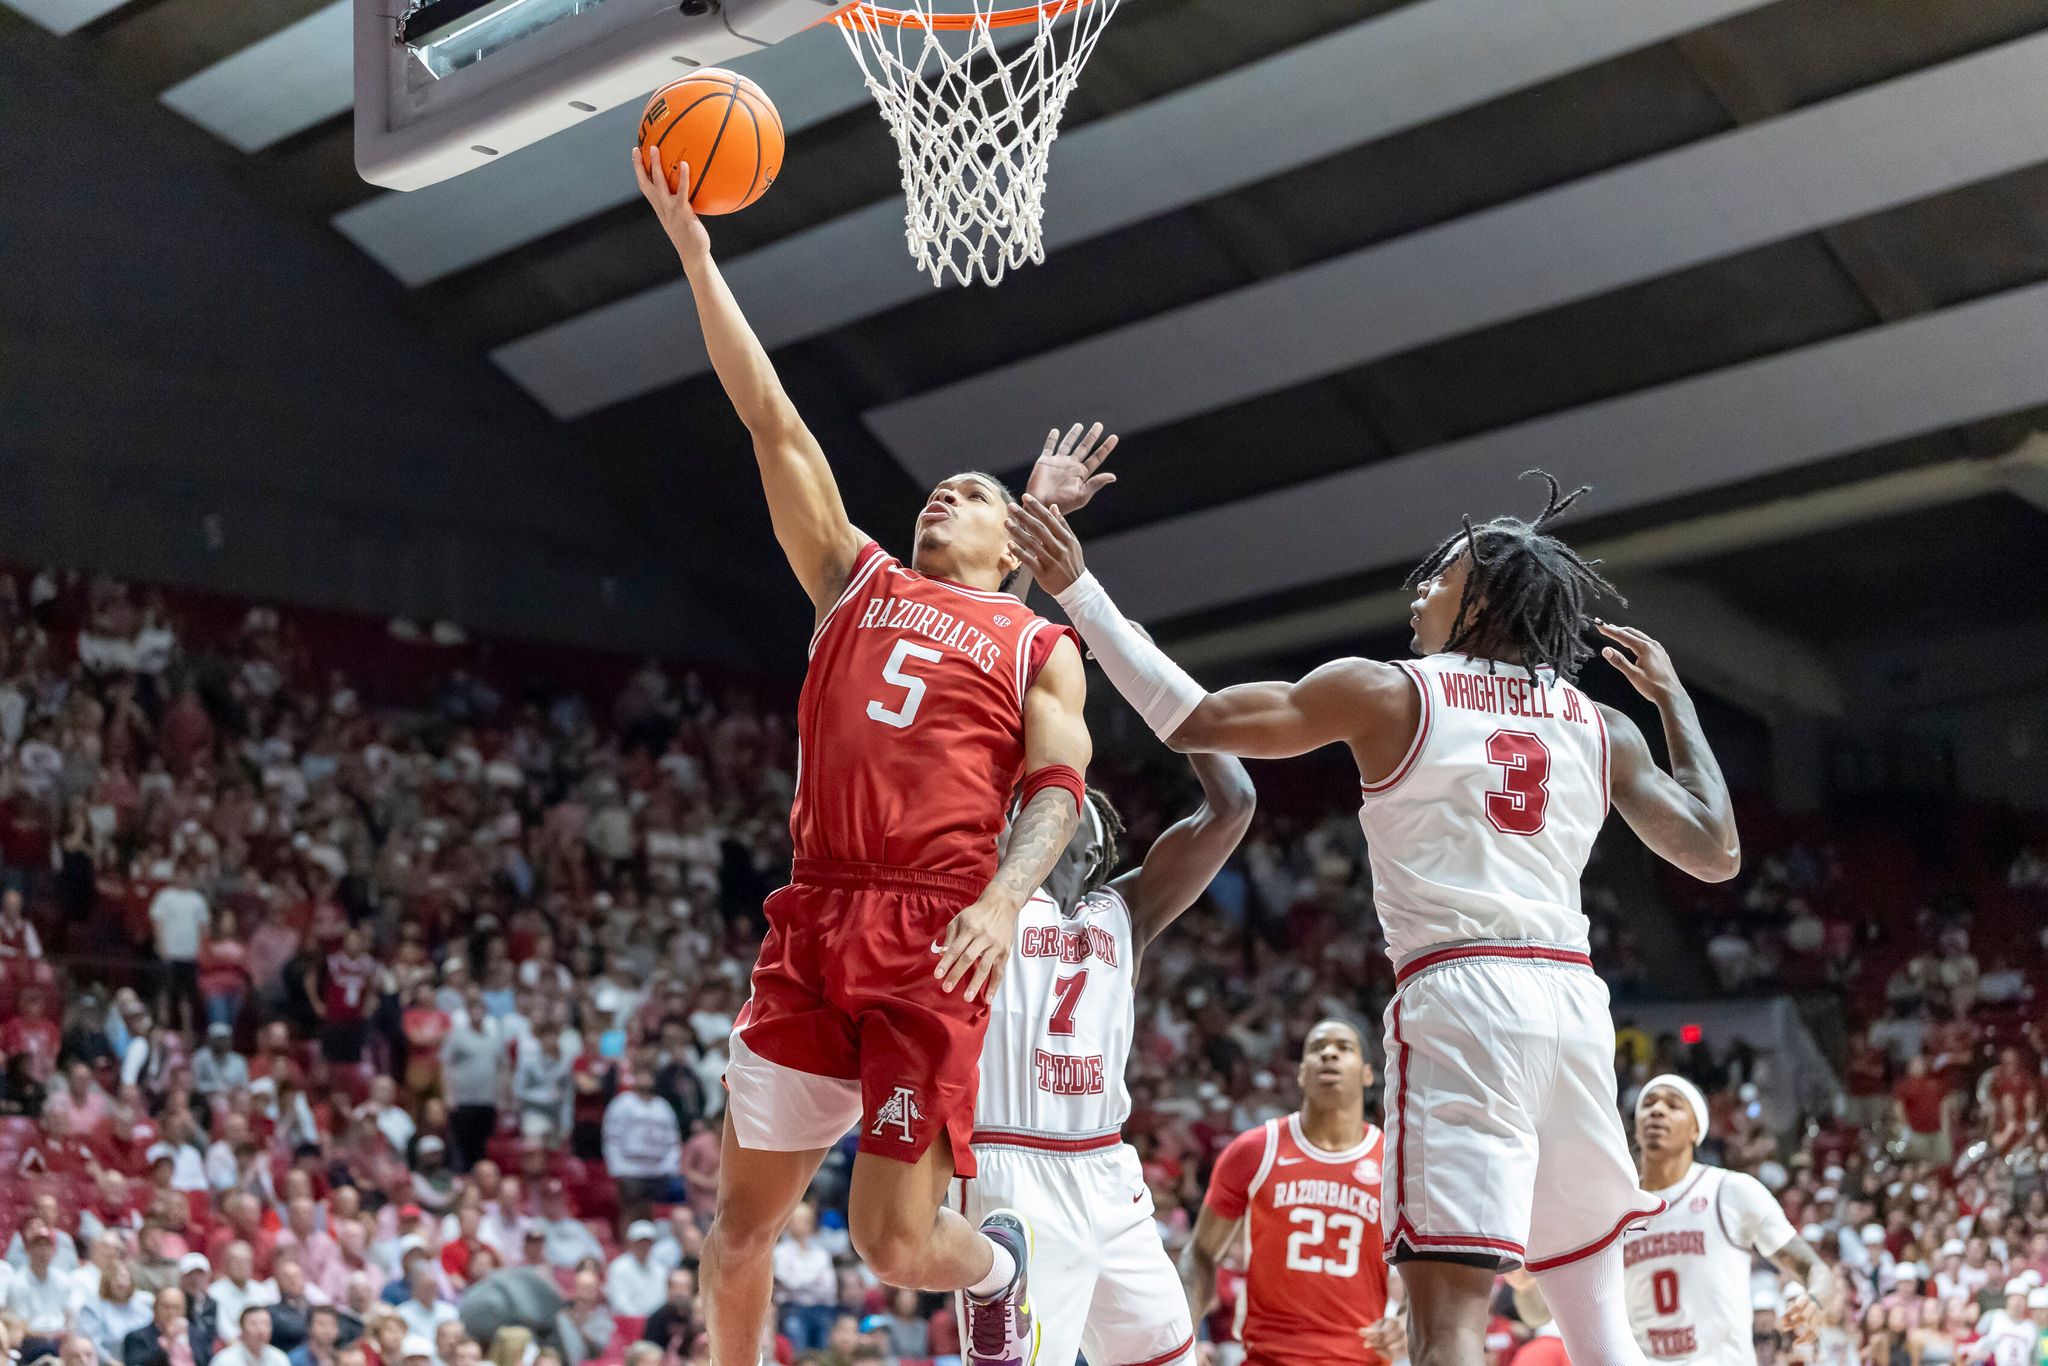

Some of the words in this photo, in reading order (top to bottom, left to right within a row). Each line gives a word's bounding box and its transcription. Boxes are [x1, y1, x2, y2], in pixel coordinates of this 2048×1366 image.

[858, 598, 1000, 674] RAZORBACKS
[866, 639, 943, 728] 5
[1439, 672, 1554, 718] WRIGHTSELL
[1562, 687, 1588, 724] JR.
[1485, 728, 1551, 836] 3
[1047, 968, 1089, 1037] 7
[1036, 1048, 1104, 1095] TIDE
[1273, 1179, 1380, 1224] RAZORBACKS
[1286, 1207, 1364, 1278] 23
[1653, 1267, 1679, 1316] 0
